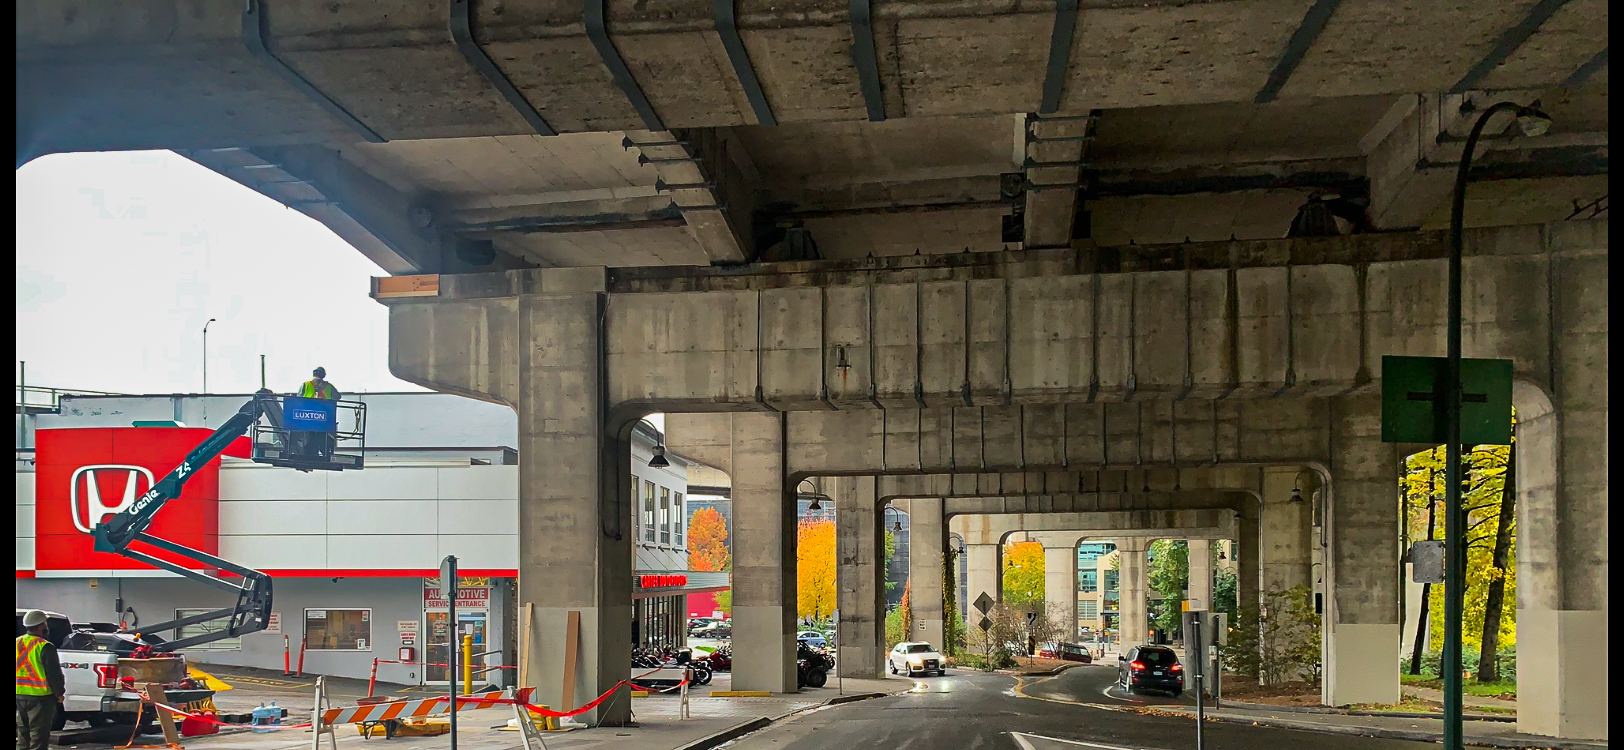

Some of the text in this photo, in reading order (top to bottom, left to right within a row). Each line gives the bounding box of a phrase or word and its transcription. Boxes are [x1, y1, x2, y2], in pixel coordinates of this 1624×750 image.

[294, 411, 326, 420] LUXTON
[128, 489, 160, 516] Genie
[428, 589, 486, 599] AUOTIVE
